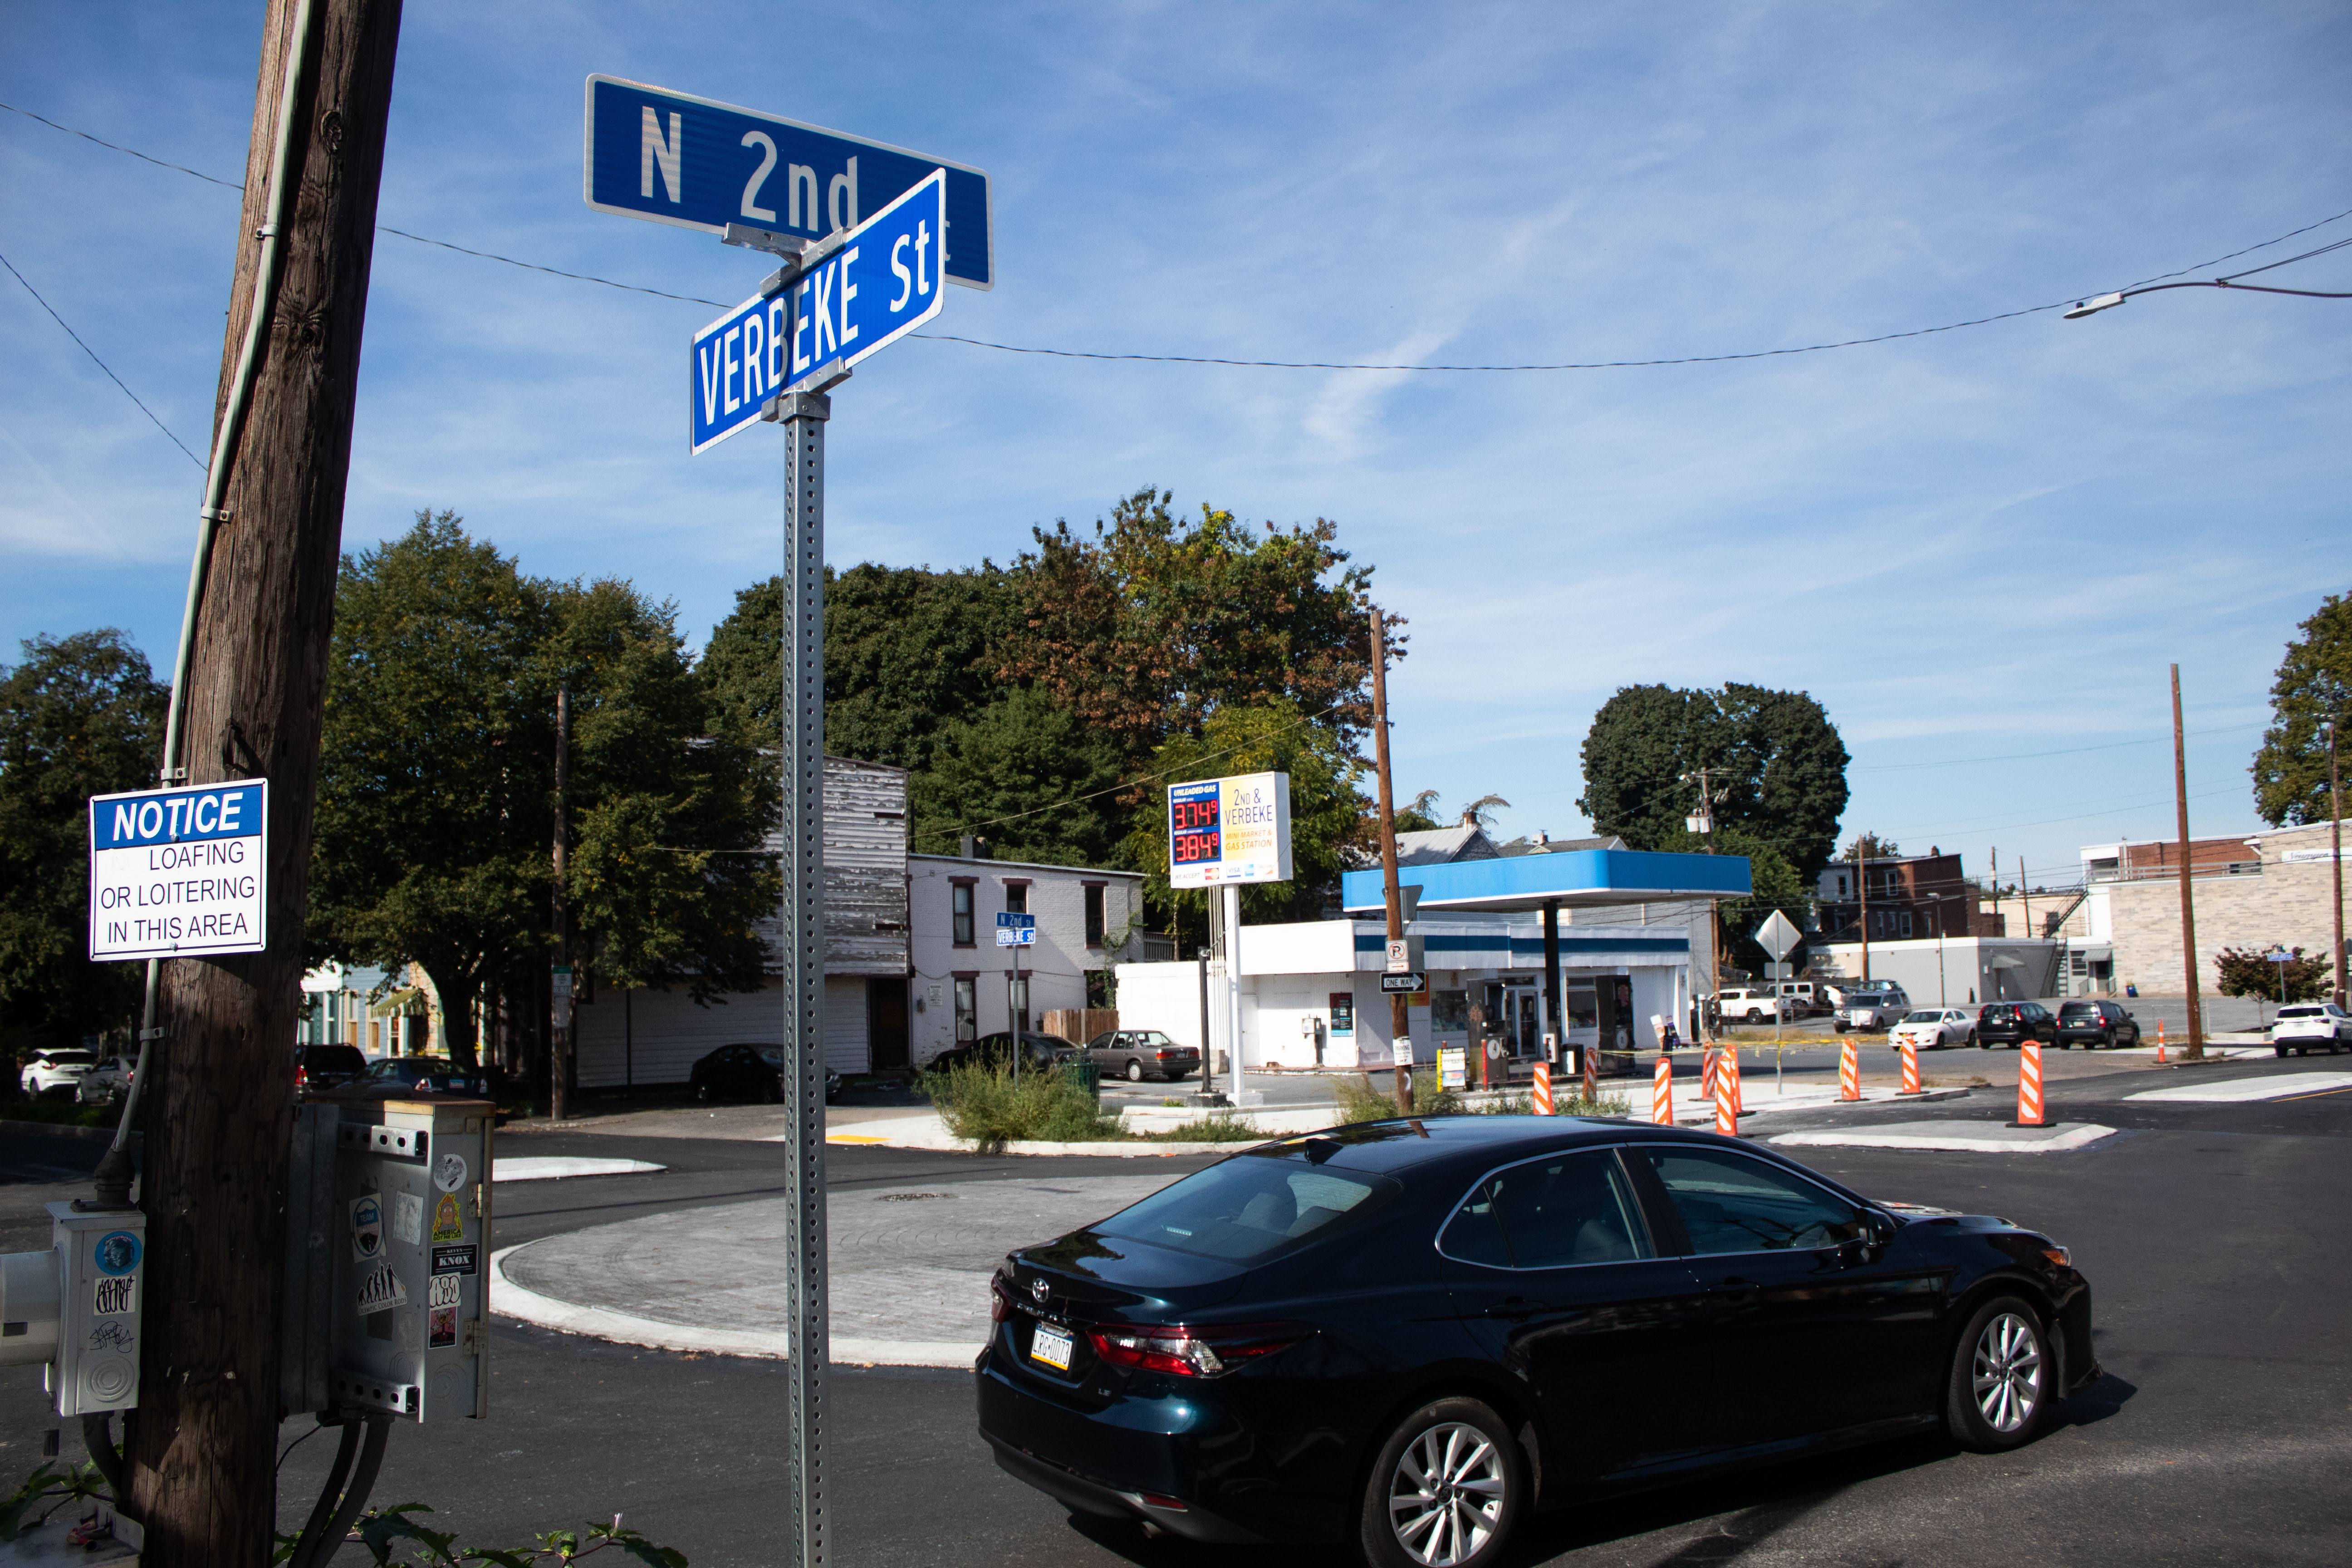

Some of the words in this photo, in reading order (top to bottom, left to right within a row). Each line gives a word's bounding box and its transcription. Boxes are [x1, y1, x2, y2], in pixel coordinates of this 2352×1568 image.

[641, 106, 681, 203] N
[740, 131, 858, 233] 2nd
[700, 245, 858, 426] VERBEKE
[890, 219, 930, 313] St
[1174, 786, 1204, 797] UNLEADED
[1204, 785, 1216, 793] GAS
[1234, 789, 1250, 806] 2ND
[1254, 788, 1261, 804] &
[113, 792, 243, 841] NOTICE
[1225, 805, 1272, 826] VERBEKE
[1240, 829, 1266, 838] MARKET
[1226, 842, 1240, 850] GAS
[1241, 839, 1272, 849] STATION
[150, 841, 244, 870] LOAFING
[101, 886, 131, 909] OR
[138, 876, 255, 906] LOITERING
[108, 921, 127, 943] IN
[134, 917, 181, 941] THIS
[188, 912, 248, 938] AREA
[1000, 914, 1005, 925] N
[1009, 915, 1021, 926] 2nd
[1027, 932, 1033, 941] St
[360, 1212, 374, 1222] TEAM
[439, 1255, 470, 1266] KNOX
[358, 1305, 377, 1314] OLYMPIC
[378, 1300, 393, 1309] COLOR
